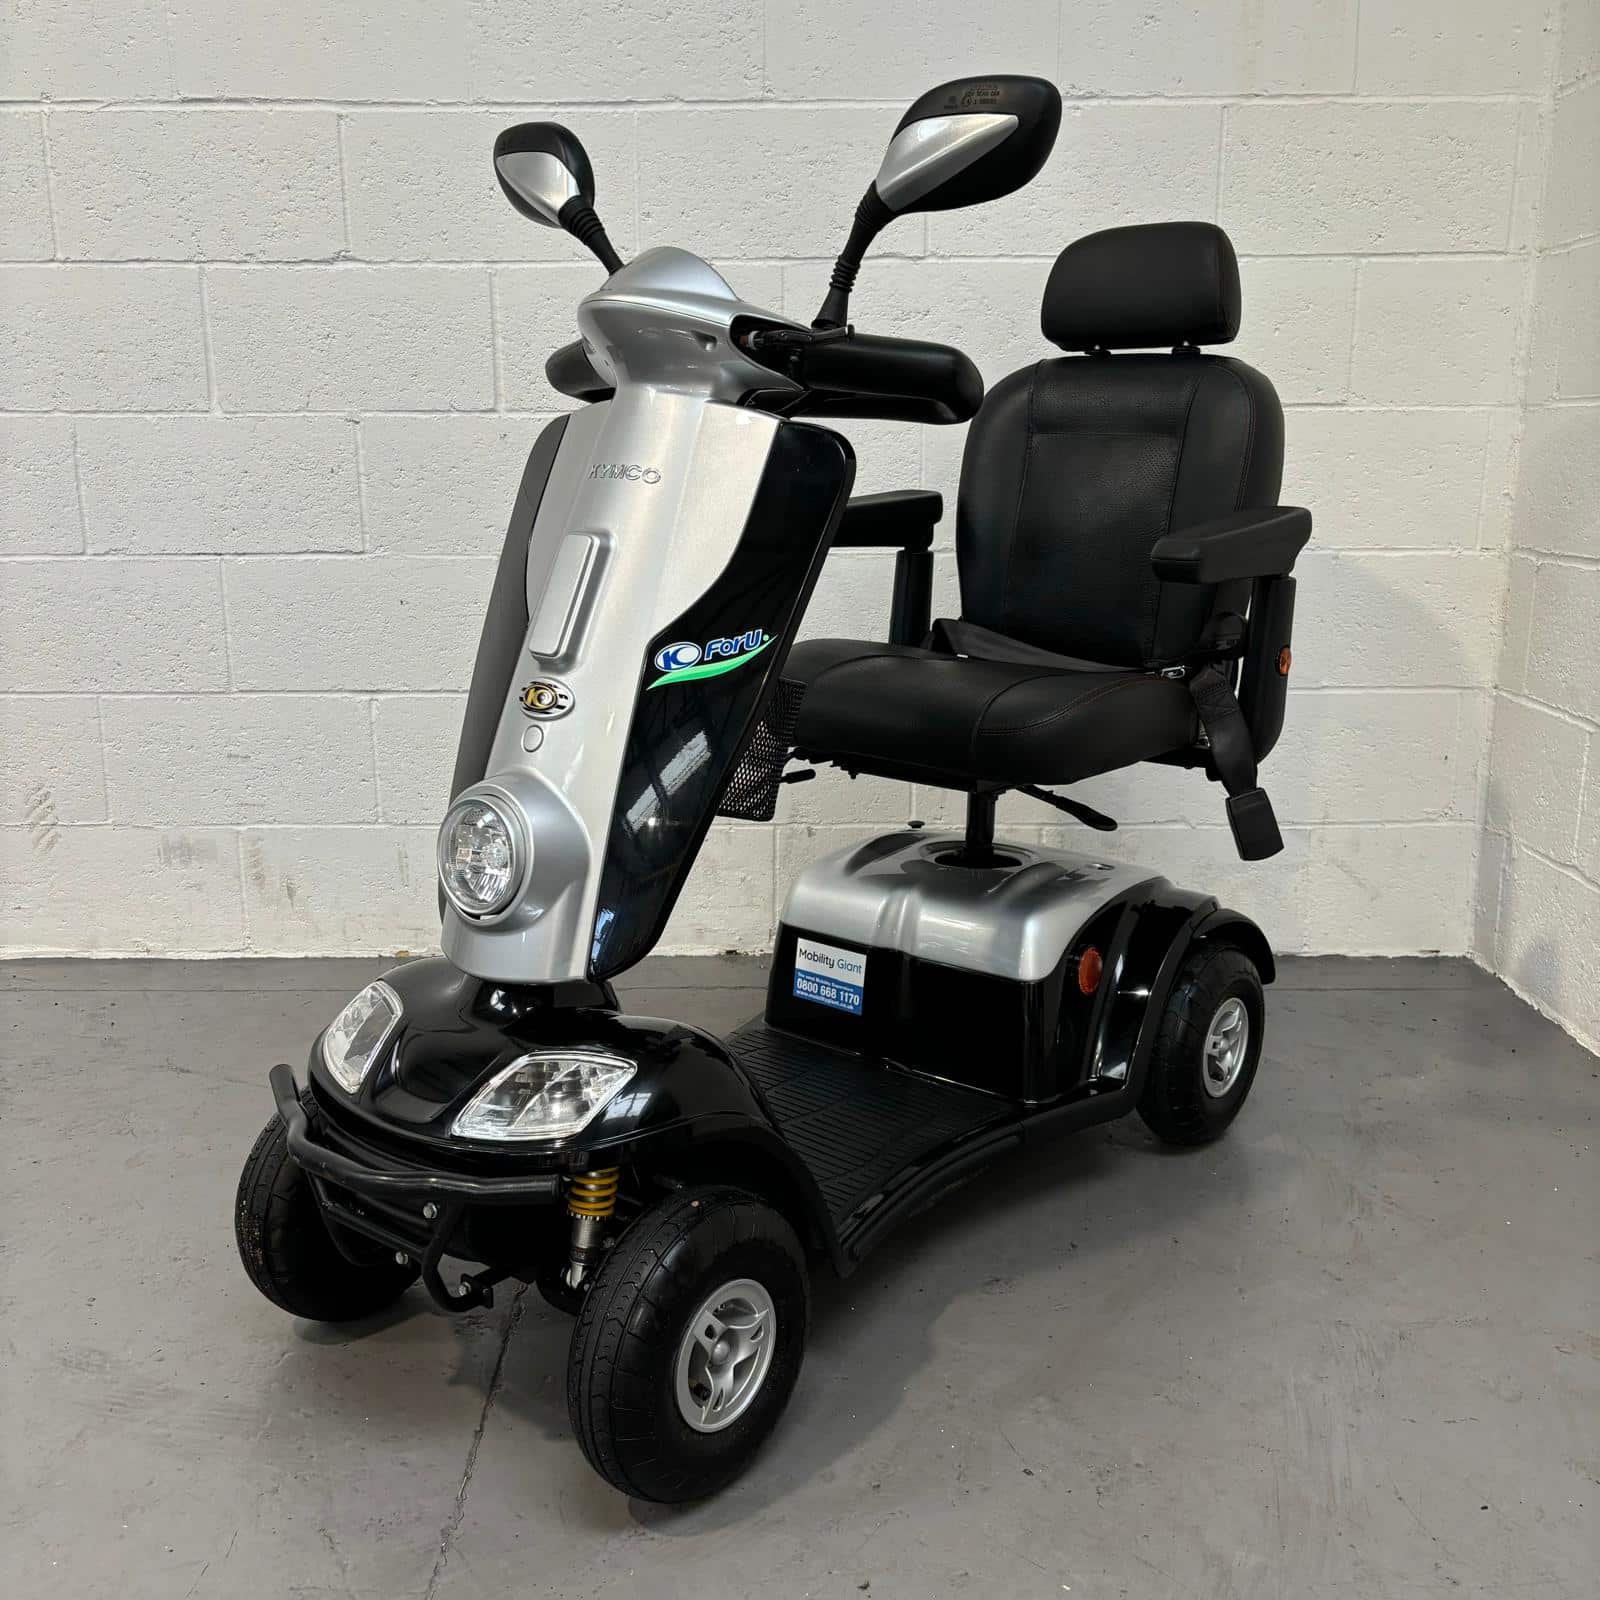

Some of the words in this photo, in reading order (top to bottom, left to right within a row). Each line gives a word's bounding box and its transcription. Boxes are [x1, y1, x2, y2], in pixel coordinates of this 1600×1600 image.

[589, 463, 662, 485] KYMCO
[799, 948, 835, 969] Mobility
[837, 959, 862, 974] Giant
[797, 978, 818, 993] 0800
[820, 985, 837, 999] 668
[840, 991, 860, 1006] 1170
